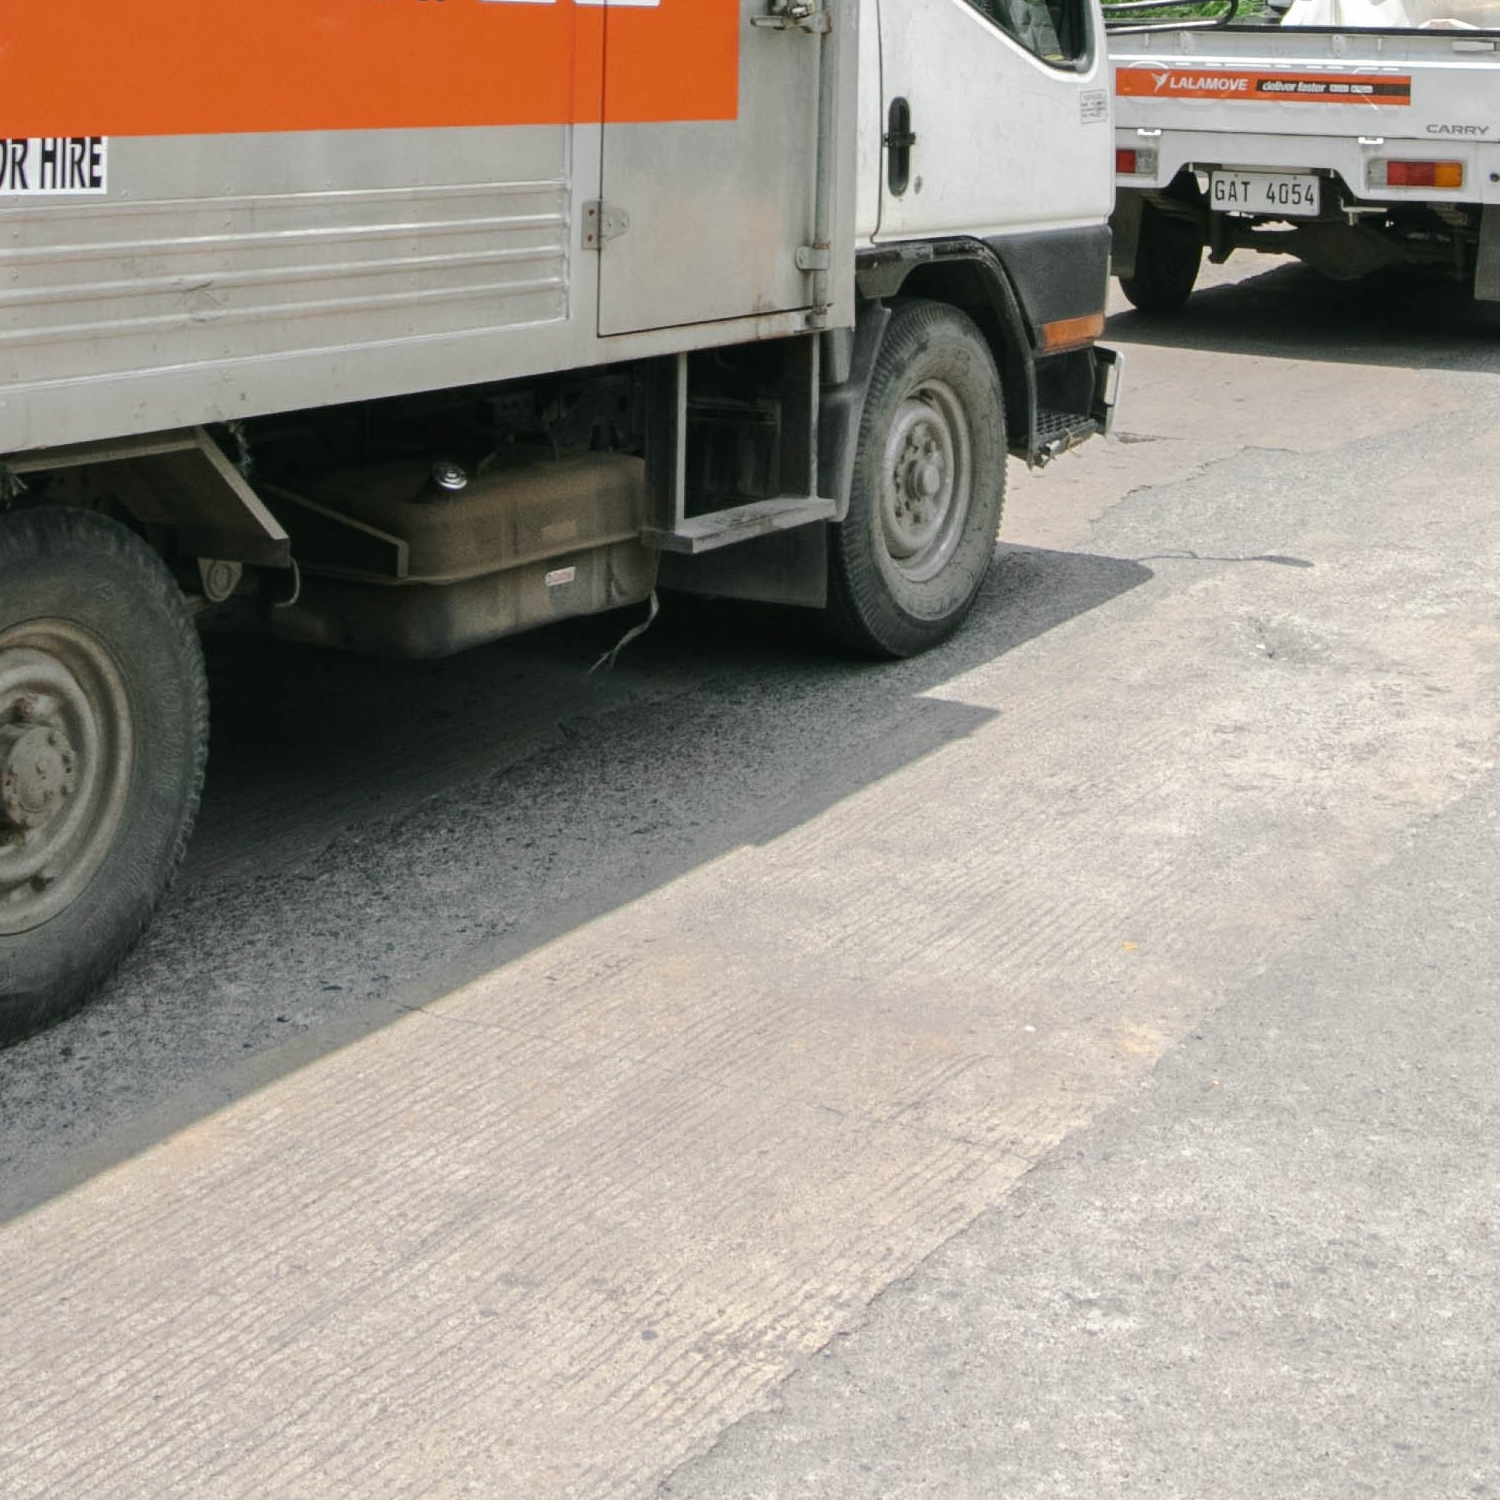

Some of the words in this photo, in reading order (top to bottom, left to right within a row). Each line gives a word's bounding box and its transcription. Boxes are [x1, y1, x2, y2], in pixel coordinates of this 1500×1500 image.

[1169, 77, 1248, 91] LALAMOVE
[1425, 122, 1490, 136] CARRY
[39, 136, 103, 190] HIRE
[1215, 180, 1251, 203] GAT
[1266, 183, 1315, 207] 4054
